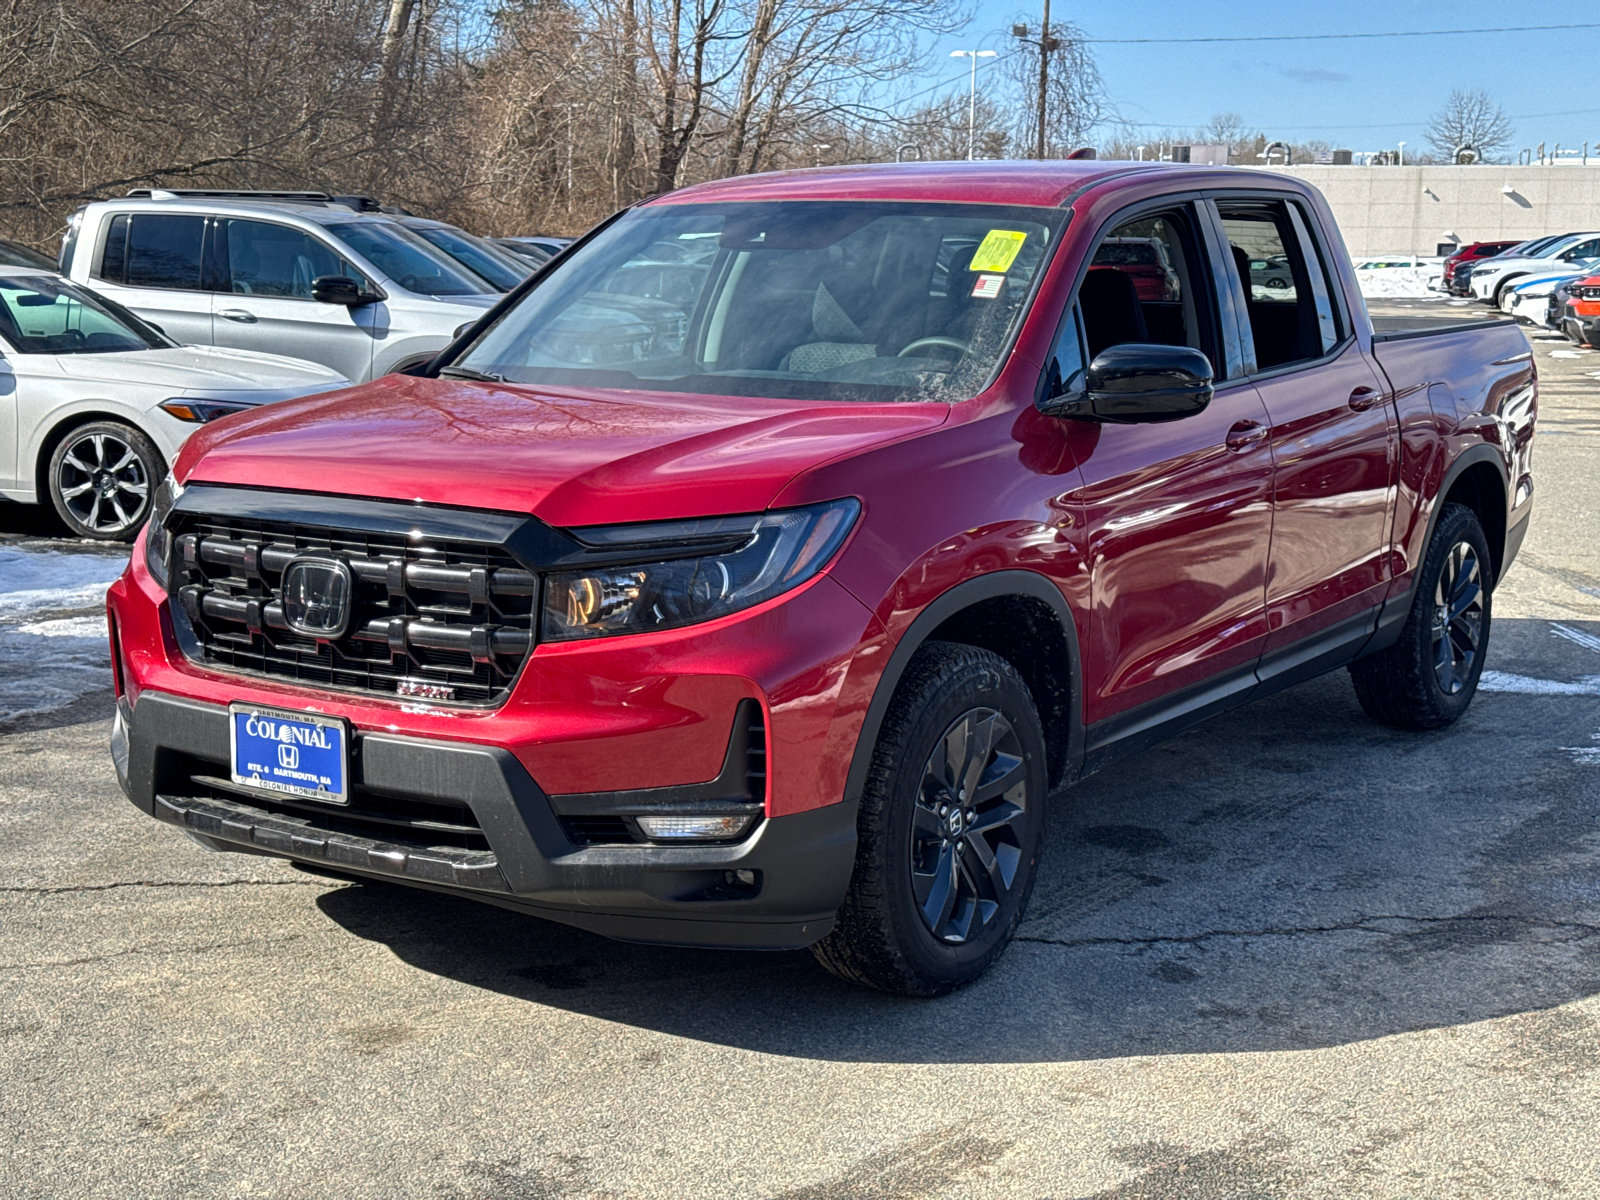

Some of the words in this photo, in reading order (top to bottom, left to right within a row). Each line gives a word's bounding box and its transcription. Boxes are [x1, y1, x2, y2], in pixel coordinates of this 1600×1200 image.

[246, 718, 331, 749] COLONIAL
[247, 763, 263, 772] RTE.
[273, 767, 319, 784] DARTMOUTH,
[320, 776, 331, 785] MA
[259, 780, 292, 793] COLONIAL
